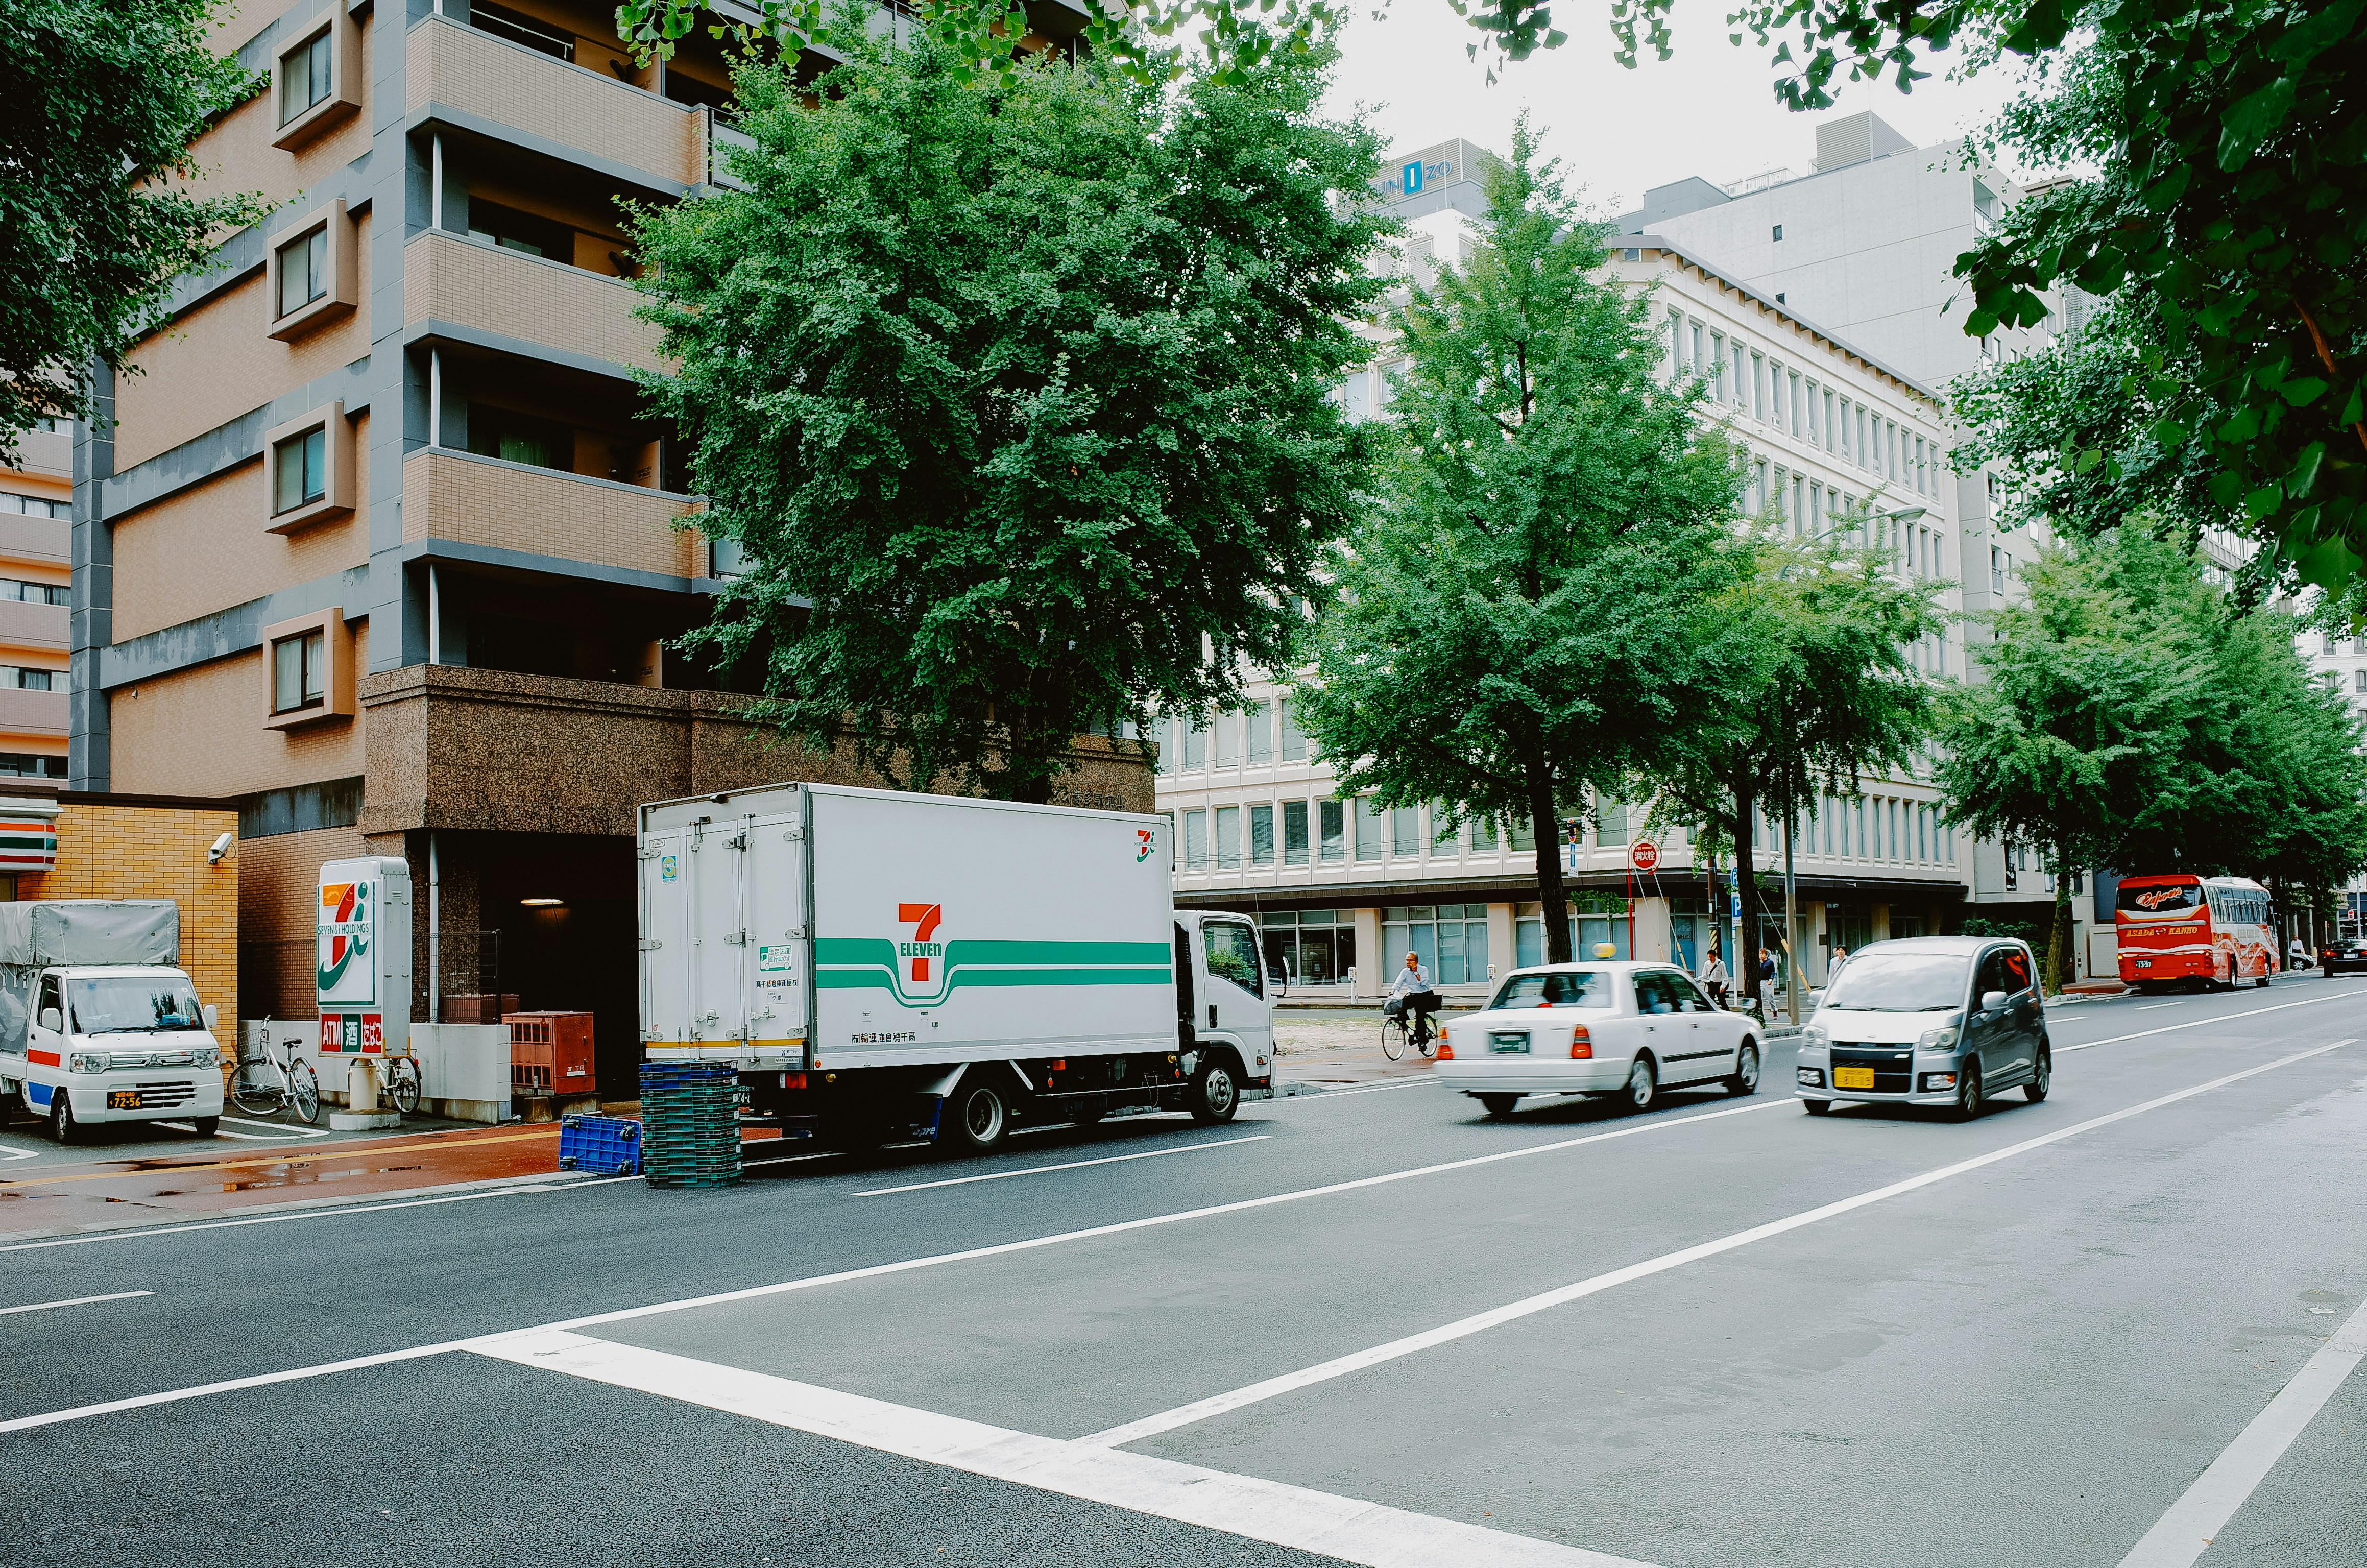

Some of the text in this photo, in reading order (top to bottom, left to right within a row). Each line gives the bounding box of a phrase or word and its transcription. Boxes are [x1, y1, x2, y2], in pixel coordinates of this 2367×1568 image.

[1634, 850, 1655, 861] 消火栓
[2136, 887, 2182, 909] Express
[1735, 899, 1741, 915] P
[341, 923, 369, 934] HOLDINGS
[2126, 929, 2154, 937] ASADA
[323, 1021, 340, 1045] ATM
[346, 1021, 358, 1046] 酒
[363, 1021, 381, 1046] たばこ
[114, 1097, 140, 1107] 72-56
